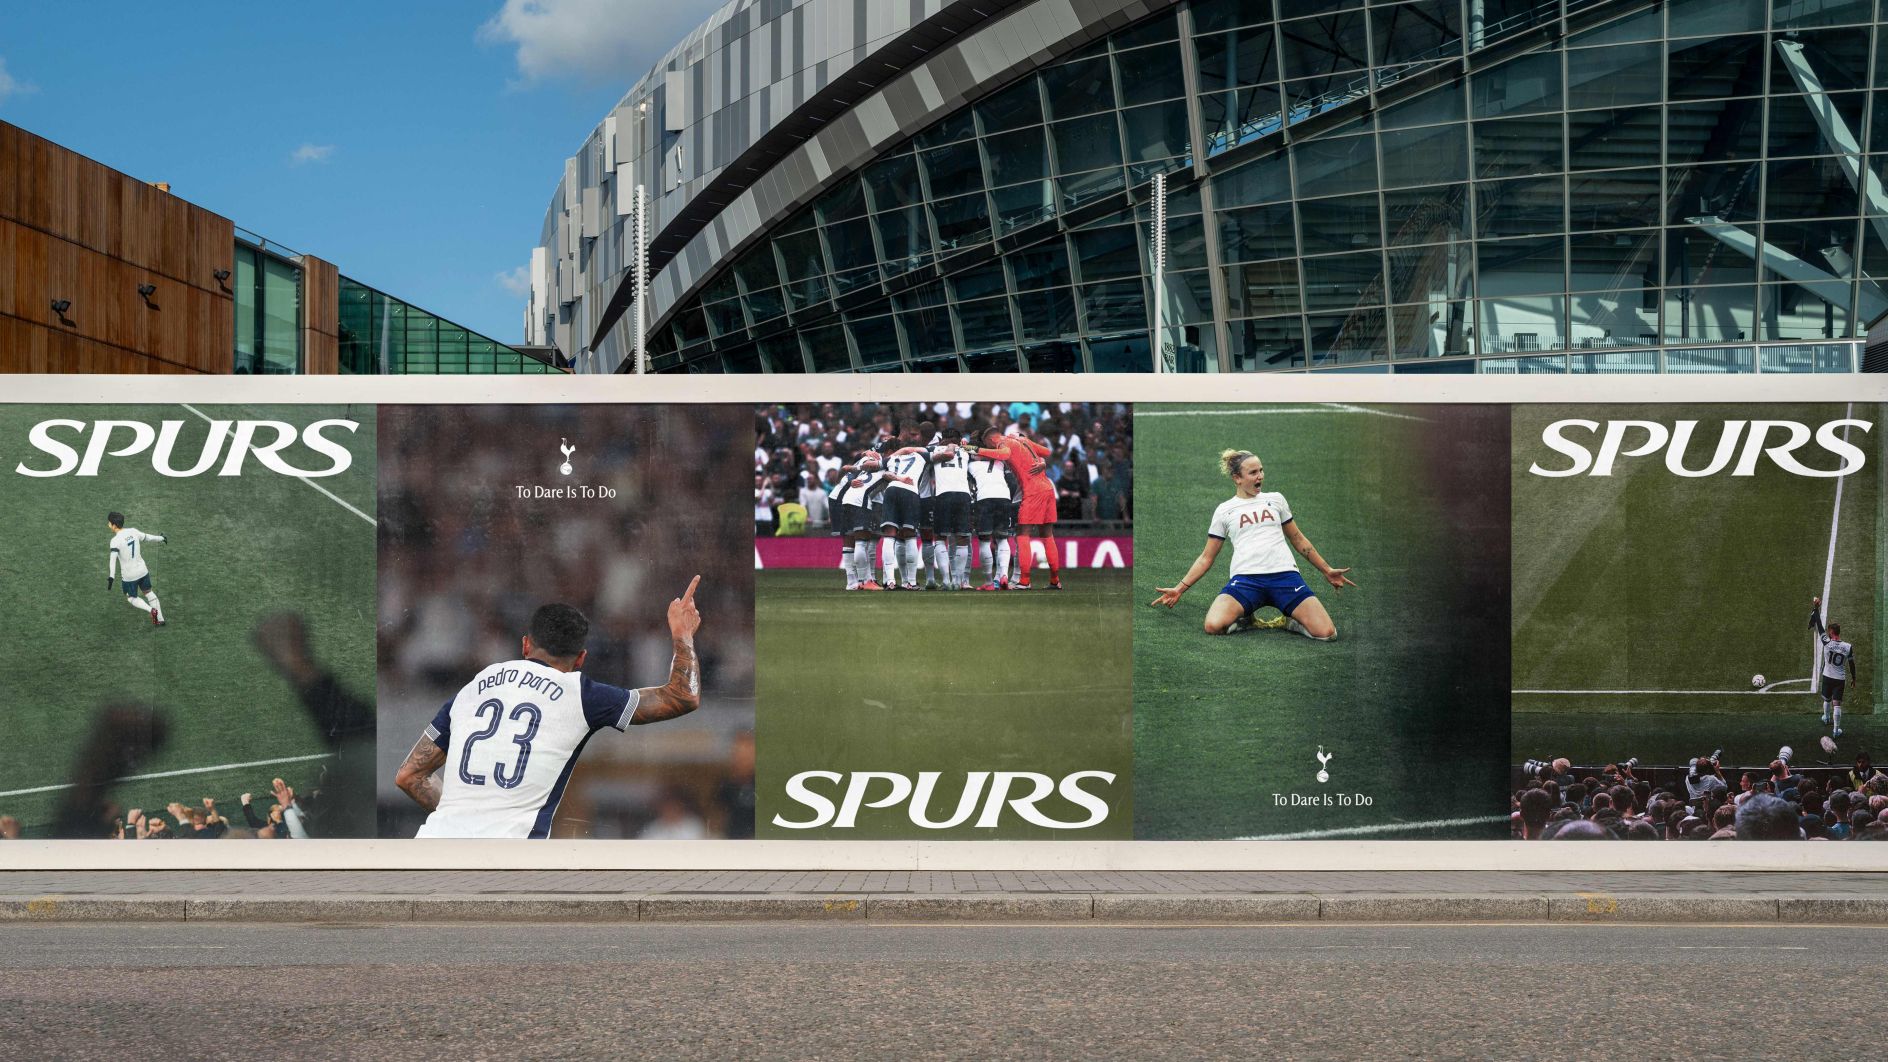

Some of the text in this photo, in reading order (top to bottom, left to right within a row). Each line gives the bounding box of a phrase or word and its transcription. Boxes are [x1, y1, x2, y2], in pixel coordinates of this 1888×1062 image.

[16, 419, 359, 477] SPURS
[1529, 419, 1872, 477] SPURS
[894, 456, 916, 475] 17
[516, 485, 616, 498] To Dare Is To Do
[1239, 509, 1275, 528] AIA
[128, 540, 135, 558] 7
[1828, 650, 1845, 666] 10
[478, 668, 563, 701] pedro porro
[459, 698, 542, 789] 23
[772, 771, 1116, 828] SPURS
[1272, 793, 1373, 806] To Dare Is To Do
